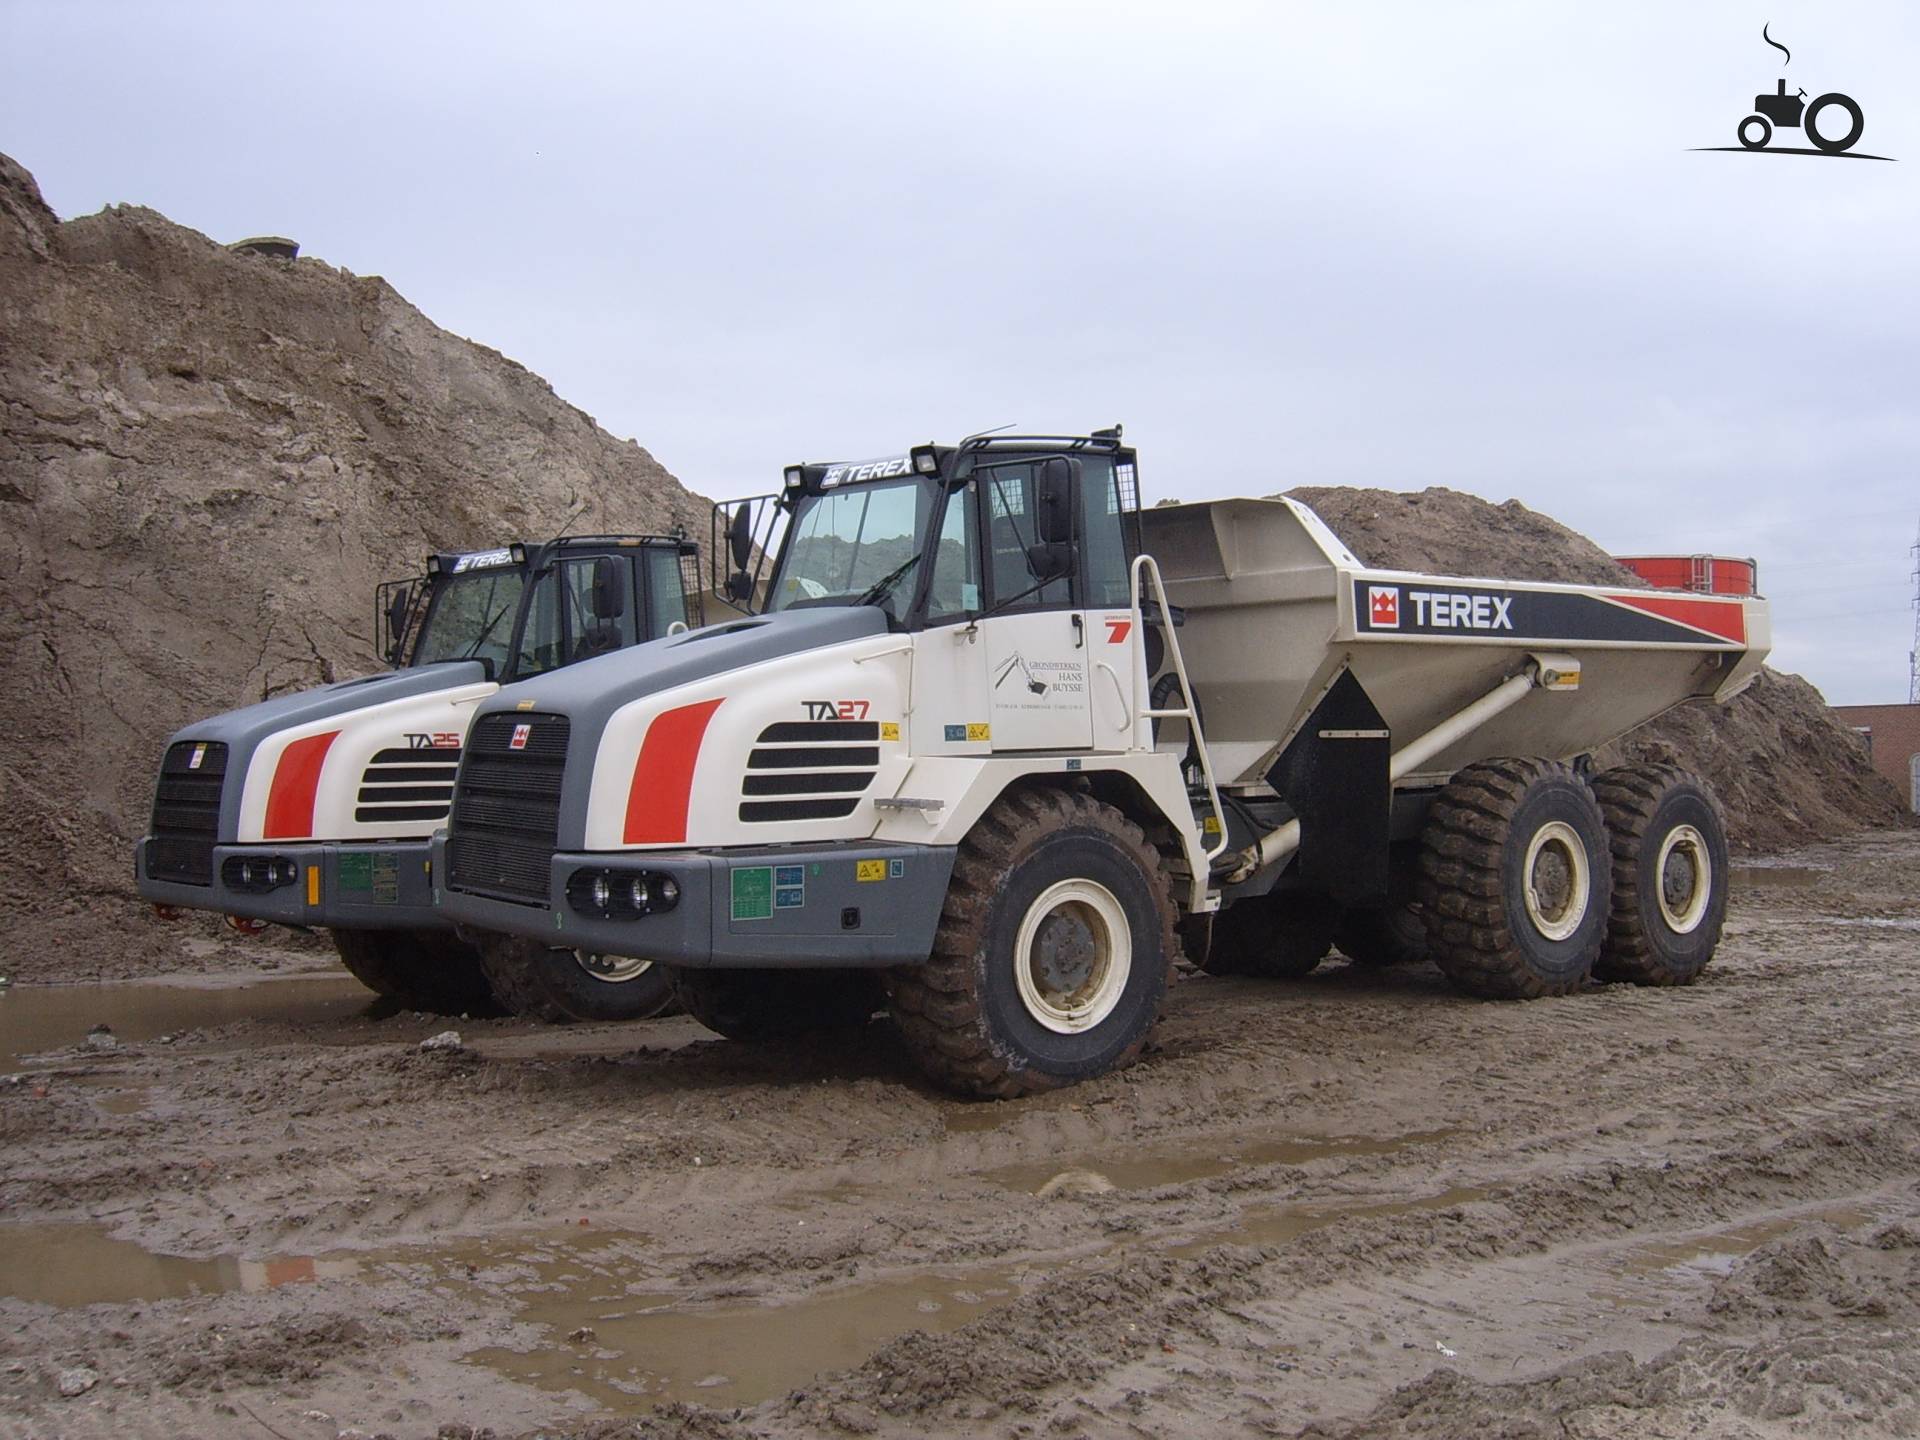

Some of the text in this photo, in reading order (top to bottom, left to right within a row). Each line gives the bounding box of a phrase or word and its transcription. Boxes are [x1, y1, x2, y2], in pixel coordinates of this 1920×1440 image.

[846, 458, 911, 482] TEREX
[1409, 592, 1512, 630] TEREX
[1104, 622, 1131, 643] 7
[1058, 672, 1083, 681] HANS
[1052, 683, 1084, 692] BUYSSE
[801, 701, 870, 720] TA27
[403, 733, 460, 748] TA25
